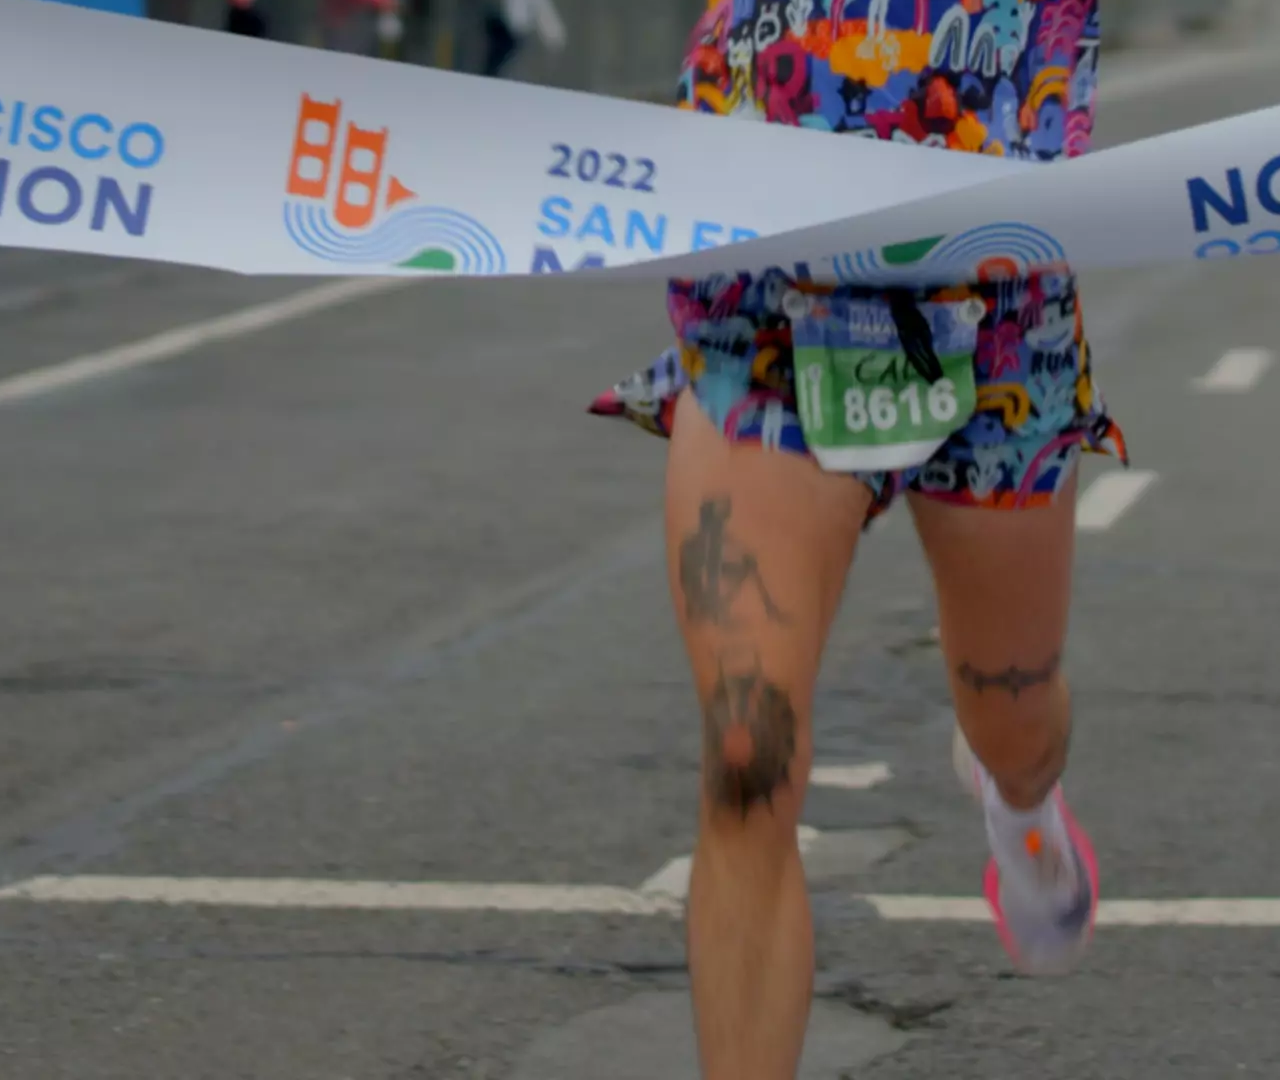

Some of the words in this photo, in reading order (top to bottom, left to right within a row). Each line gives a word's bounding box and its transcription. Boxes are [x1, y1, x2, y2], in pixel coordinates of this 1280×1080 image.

[547, 143, 657, 193] 2022
[535, 193, 670, 257] SAN
[844, 378, 957, 432] 8616
